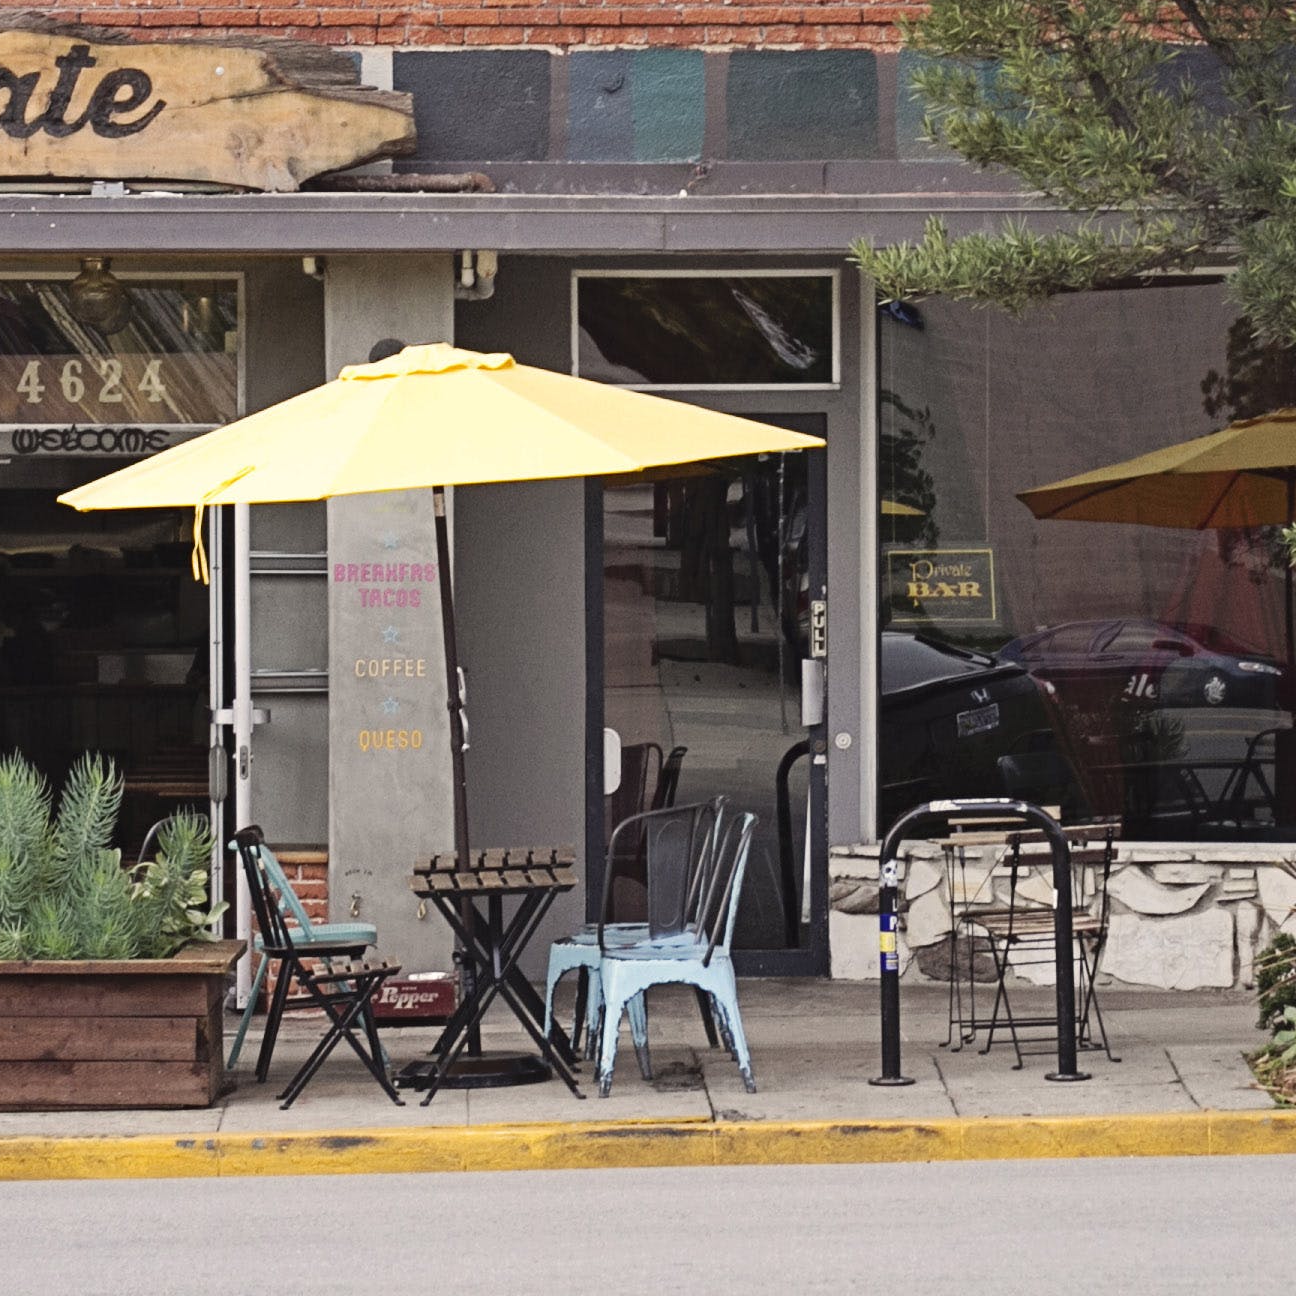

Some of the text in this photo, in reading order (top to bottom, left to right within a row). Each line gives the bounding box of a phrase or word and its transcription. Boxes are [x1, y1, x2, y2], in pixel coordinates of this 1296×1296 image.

[16, 360, 166, 404] 4624
[12, 424, 171, 454] WELCOME
[333, 563, 438, 582] BREAKFAS
[909, 560, 973, 582] Private
[358, 588, 422, 608] TACOS
[907, 582, 982, 597] BAR
[813, 603, 825, 653] PULL
[355, 659, 426, 677] COFFEE
[359, 730, 422, 751] QUESO
[379, 986, 439, 1009] Pepper
